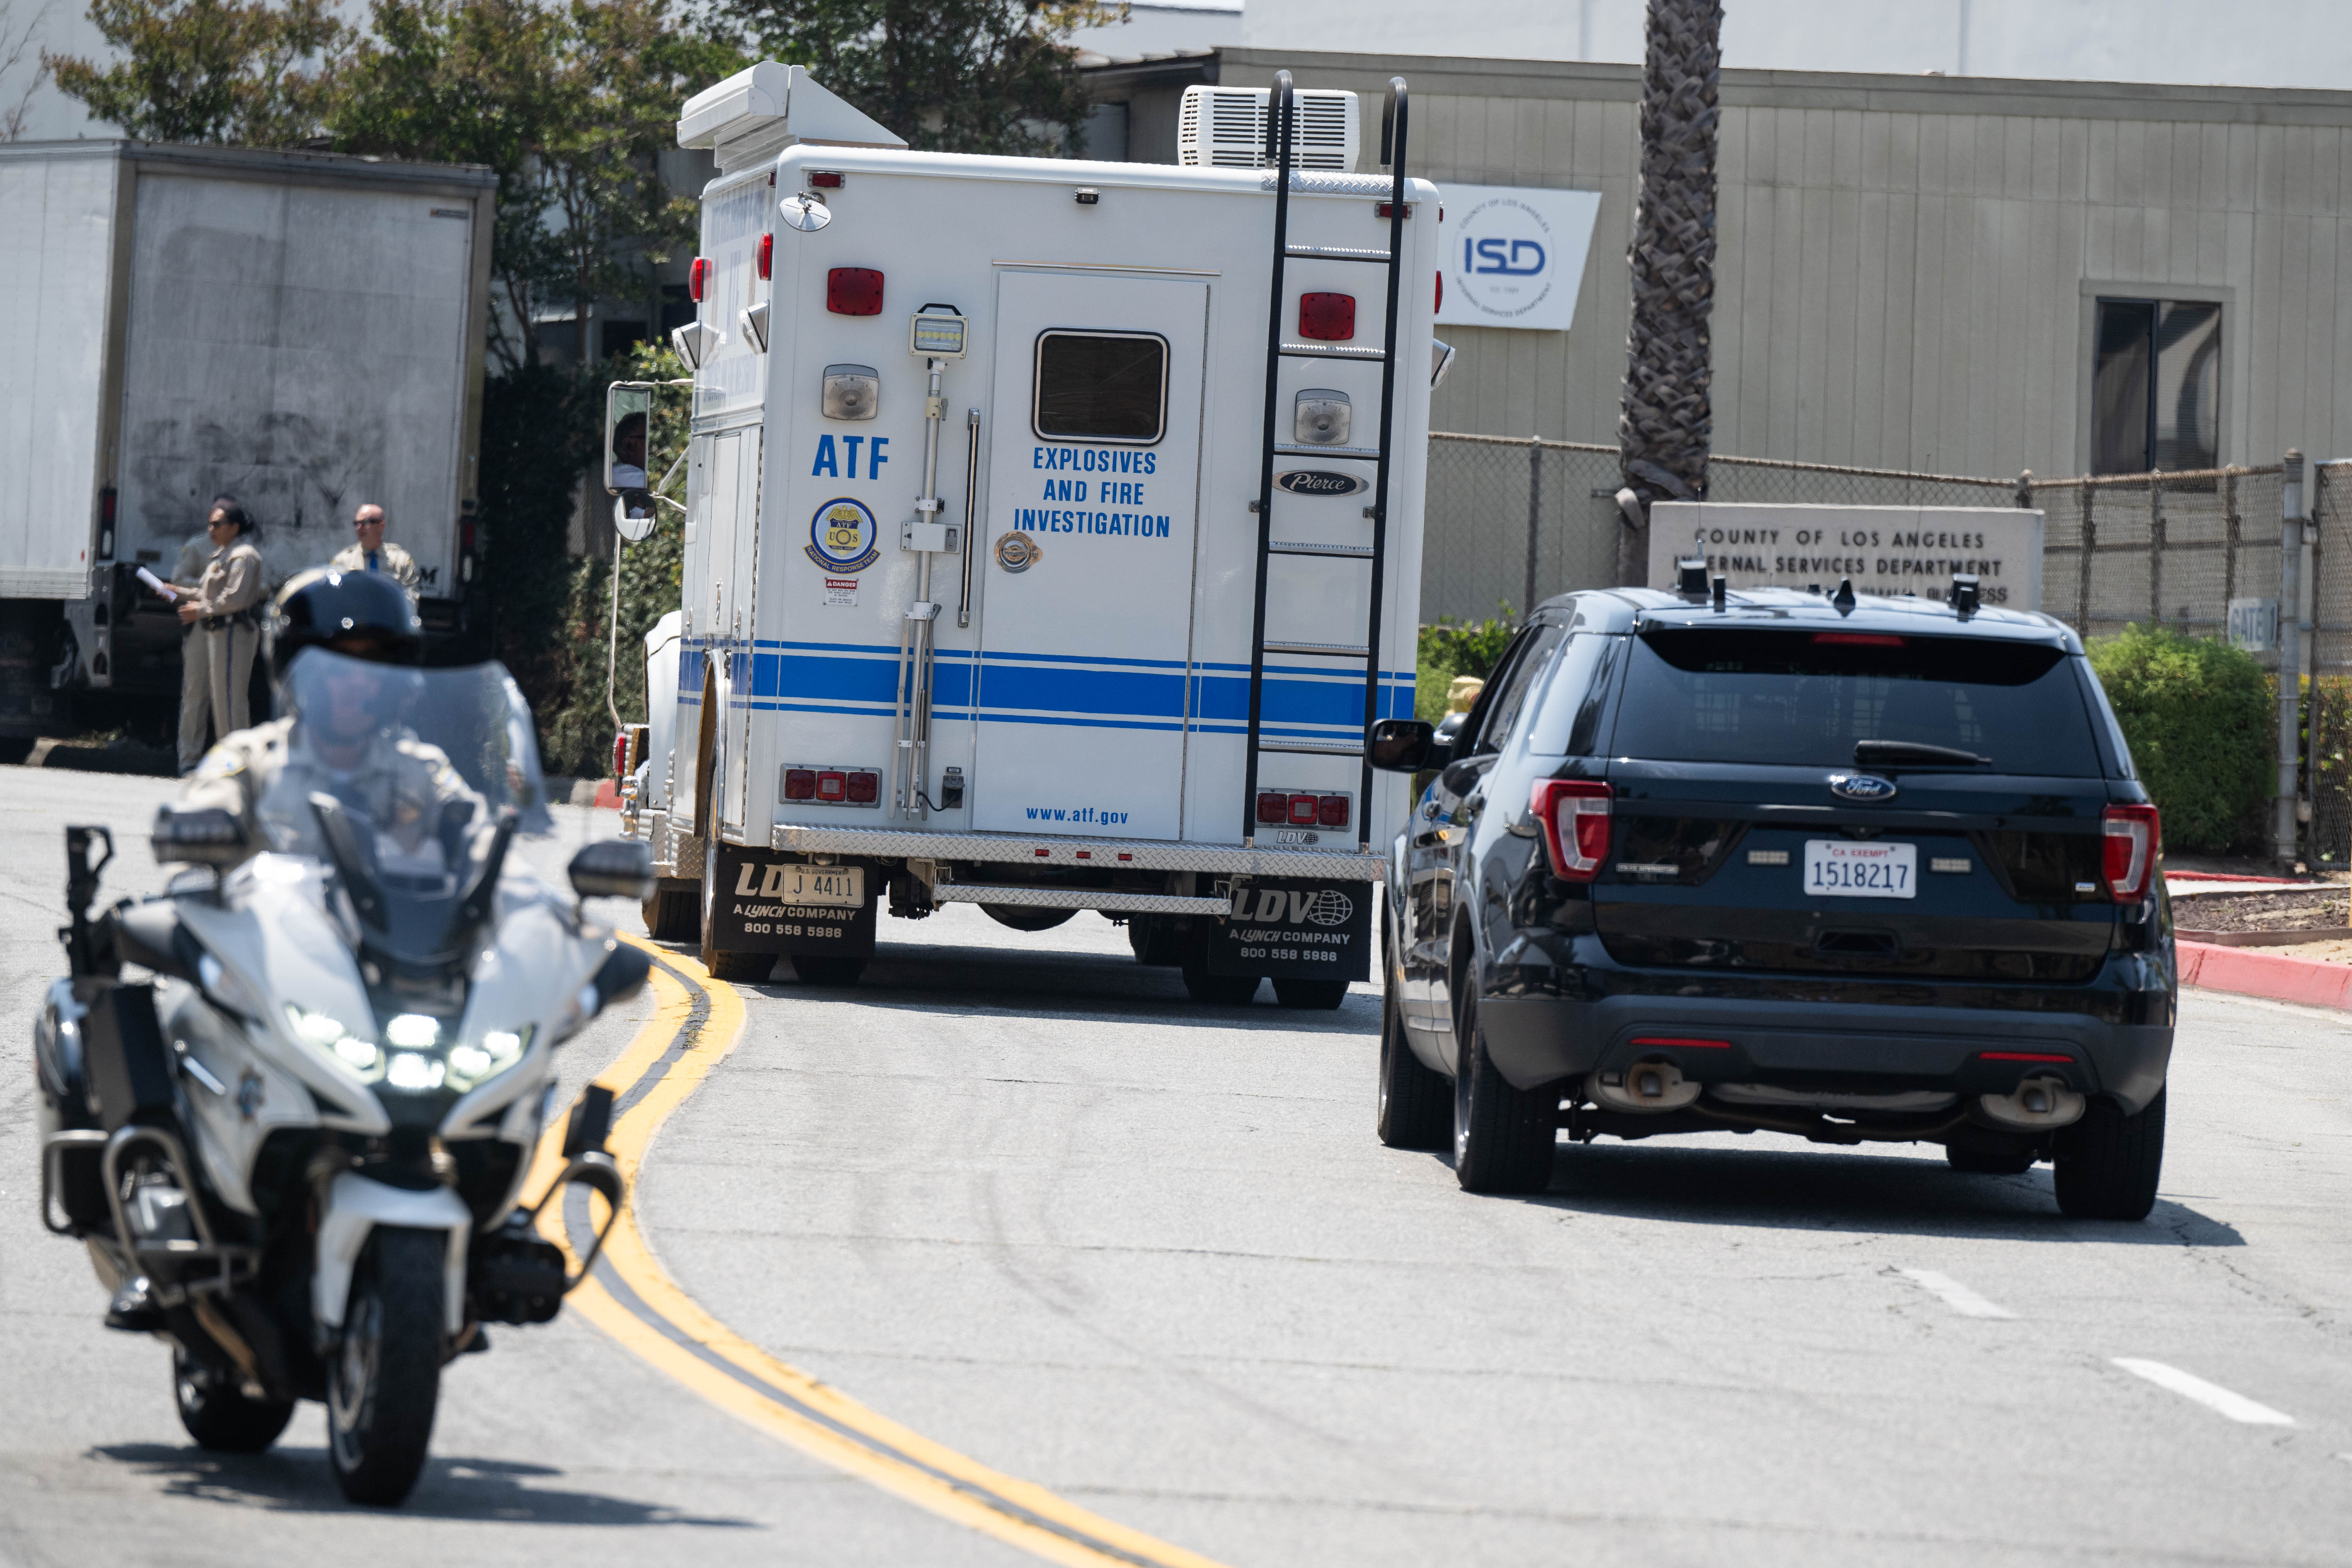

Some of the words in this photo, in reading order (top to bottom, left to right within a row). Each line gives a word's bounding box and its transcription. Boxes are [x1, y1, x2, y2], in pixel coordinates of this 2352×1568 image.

[1465, 238, 1545, 276] ISD
[812, 434, 889, 480] ATF
[1034, 447, 1156, 474] EXPLOSIVES
[1290, 473, 1345, 490] Pierce
[1043, 479, 1087, 501] AND
[1101, 482, 1144, 505] FIRE
[1014, 509, 1169, 537] INVESTIGATION
[830, 532, 835, 540] U
[853, 534, 858, 542] S
[1695, 529, 1779, 545] COUNTY
[1796, 530, 1823, 545] OF
[1841, 531, 1879, 547] LOS
[1893, 532, 1984, 549] ANGELES
[807, 546, 830, 569] NATIONAL
[832, 563, 864, 572] RESPONSE
[865, 551, 878, 565] TEAM
[1776, 556, 1864, 574] SERVICES
[1877, 558, 2002, 576] DEPARTMENT
[2231, 607, 2263, 642] GATE
[2271, 607, 2275, 641] 1
[1846, 779, 1882, 795] Ford
[1026, 808, 1128, 825] www.atf.gov
[1277, 831, 1308, 844] LDV
[1832, 849, 1845, 857] CA
[1851, 849, 1888, 857] EXEMPT
[1813, 861, 1908, 889] 1518217
[793, 875, 802, 894] J
[814, 876, 852, 896] 4411
[733, 904, 743, 914] A
[744, 905, 786, 917] LYNCH
[788, 907, 856, 921] COMPANY
[1230, 888, 1318, 923] LDV
[744, 923, 770, 933] 800
[776, 924, 801, 935] 558
[808, 926, 842, 938] 5986
[1229, 929, 1238, 938] A
[1240, 930, 1281, 942] LYNCH
[1283, 931, 1350, 944] COMPANY
[1241, 948, 1266, 957] 800
[1271, 949, 1297, 959] 558
